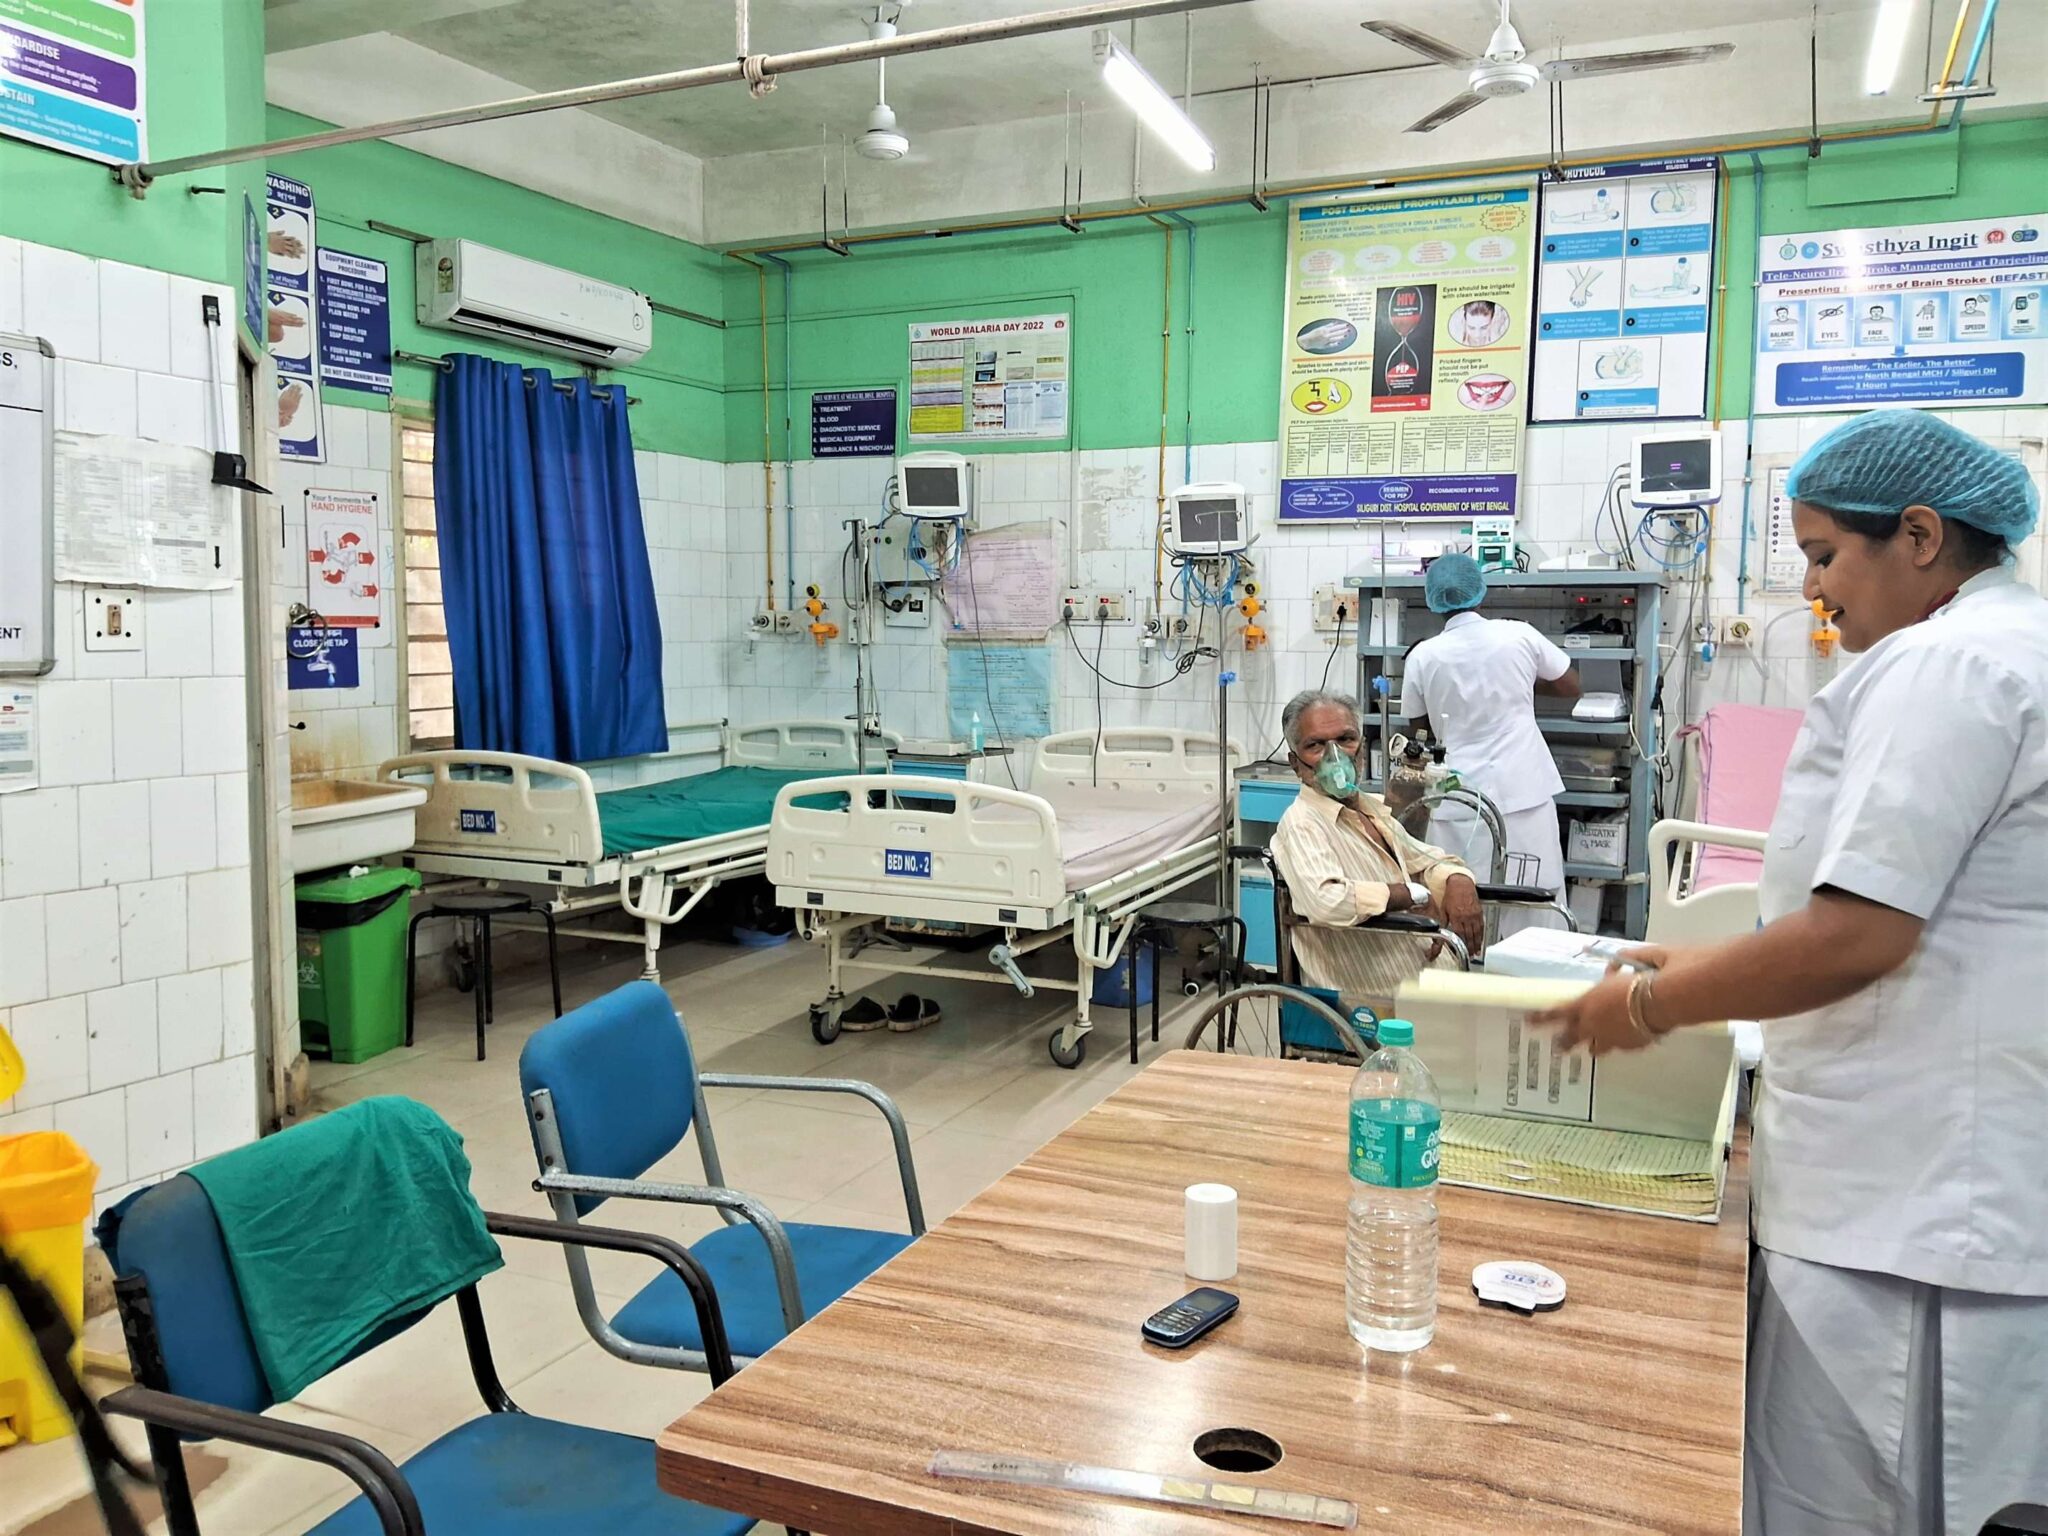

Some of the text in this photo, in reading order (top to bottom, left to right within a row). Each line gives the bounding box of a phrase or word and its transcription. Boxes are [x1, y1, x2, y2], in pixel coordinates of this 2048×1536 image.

[1321, 206, 1348, 216] POST
[1403, 193, 1475, 210] PROPHYLAXIS
[272, 207, 279, 216] 2
[1928, 232, 1979, 251] Ingit
[1864, 264, 1898, 277] troke
[1900, 259, 1971, 272] Management
[1974, 259, 1987, 268] at
[1778, 271, 2048, 299] Presenting of Brain Stroke (BEFAST
[1396, 293, 1416, 306] HIV
[930, 321, 1045, 338] WORLD MALARIA DAY 2022
[0, 351, 18, 370] S,
[1822, 362, 1870, 373] Remember,
[1926, 359, 1942, 368] The
[1395, 364, 1410, 374] PEP
[1864, 371, 1890, 381] North
[1891, 369, 1920, 380] Bengal
[1922, 368, 1943, 378] MCH
[1951, 367, 1982, 378] Siliguri
[1983, 367, 1997, 376] DH
[1862, 381, 1888, 390] Hours
[1953, 388, 1974, 397] Free
[1975, 387, 1987, 396] of
[1987, 386, 2009, 396] Cost
[819, 405, 852, 413] TREATMENT
[819, 445, 853, 453] AMBULANCE
[311, 502, 373, 514] HAND HYGIENE
[1356, 503, 1379, 513] SILIGURI
[1393, 502, 1420, 512] HOSPITAL
[1420, 502, 1461, 512] GOVERNMENT
[1461, 502, 1470, 512] OF
[1470, 501, 1486, 511] WEST
[1486, 501, 1510, 511] BENGAL
[0, 627, 22, 640] ENT
[293, 637, 317, 648] CLOSE
[334, 638, 349, 648] TAP
[462, 812, 495, 830] BED NO. 1
[887, 853, 903, 871] BED
[904, 855, 919, 873] NO.
[923, 856, 930, 873] 2
